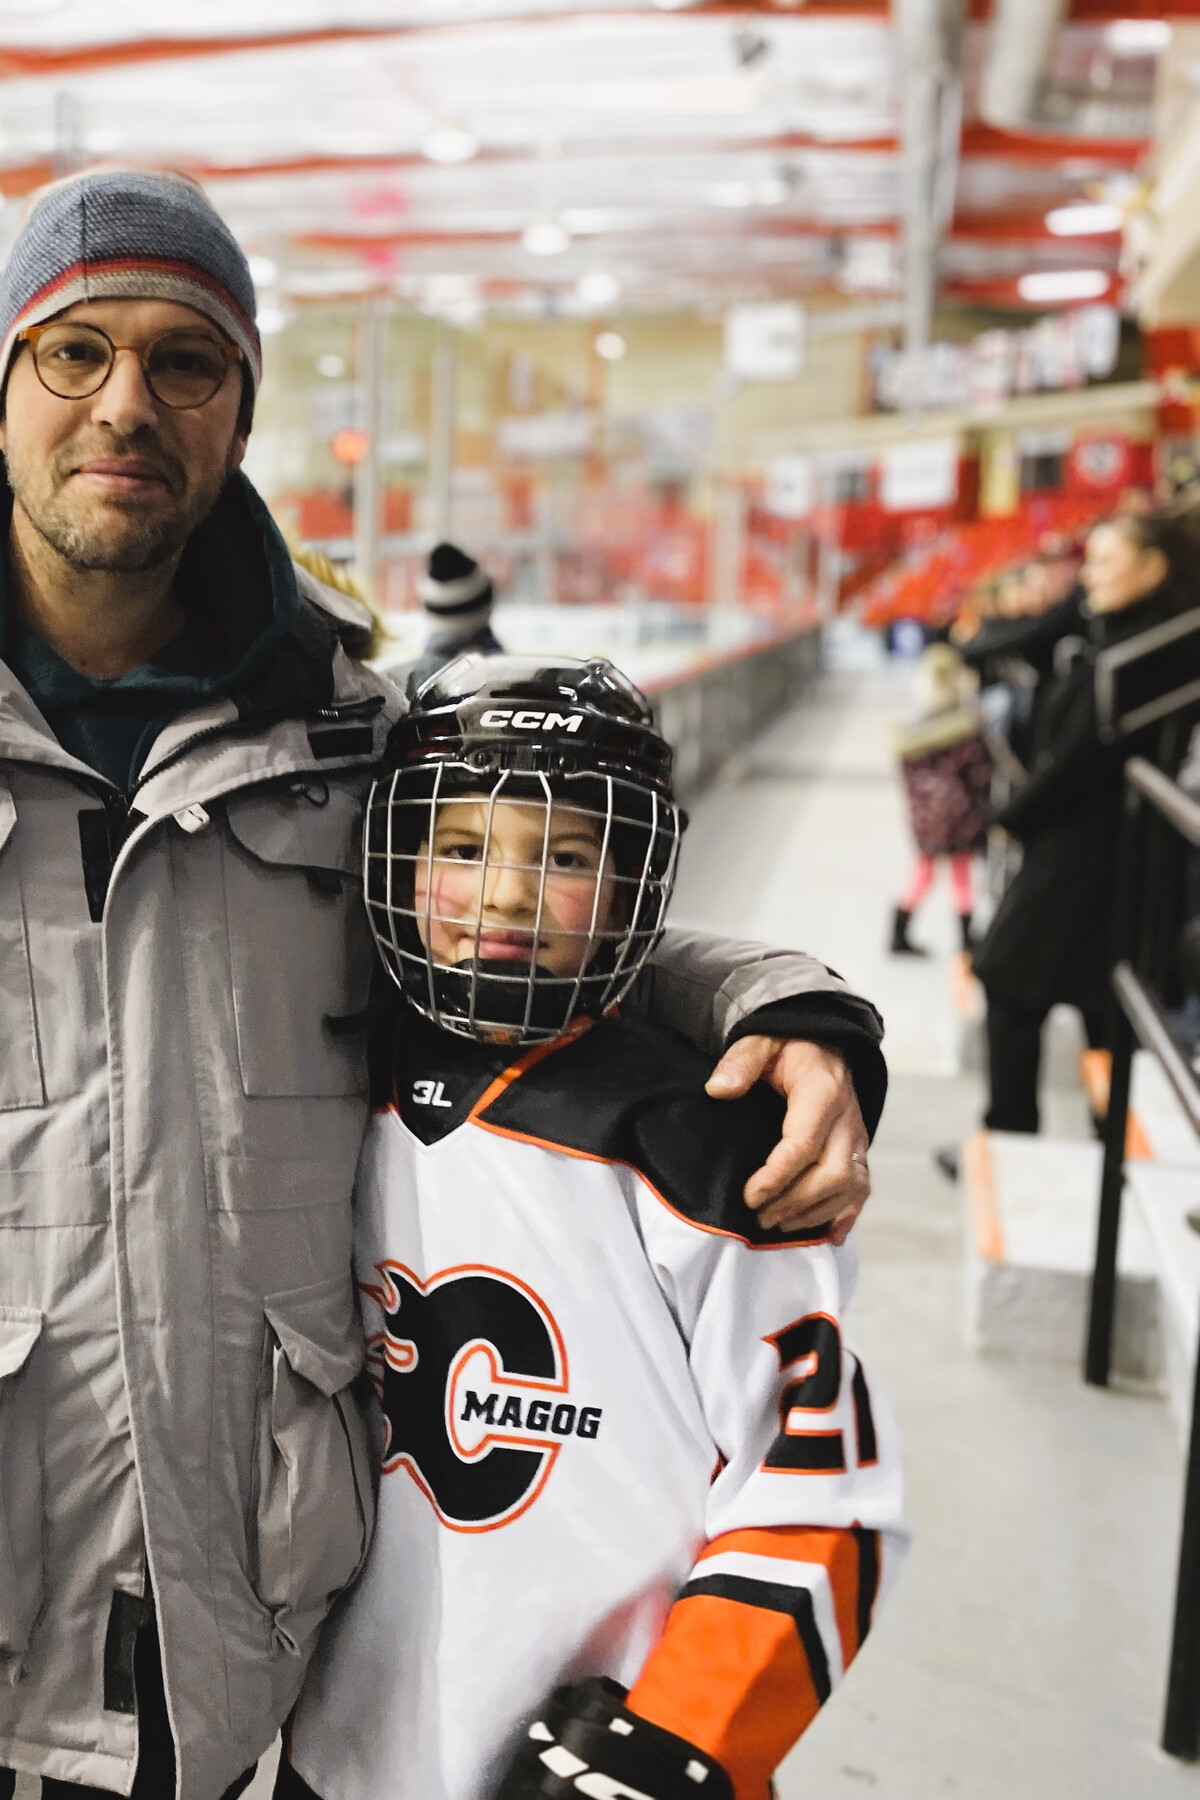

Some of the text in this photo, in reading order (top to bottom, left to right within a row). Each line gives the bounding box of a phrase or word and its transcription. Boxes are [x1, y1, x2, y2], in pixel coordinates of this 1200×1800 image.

[480, 710, 584, 732] CCM
[412, 1080, 452, 1108] 3L
[460, 1390, 603, 1440] MAGOG
